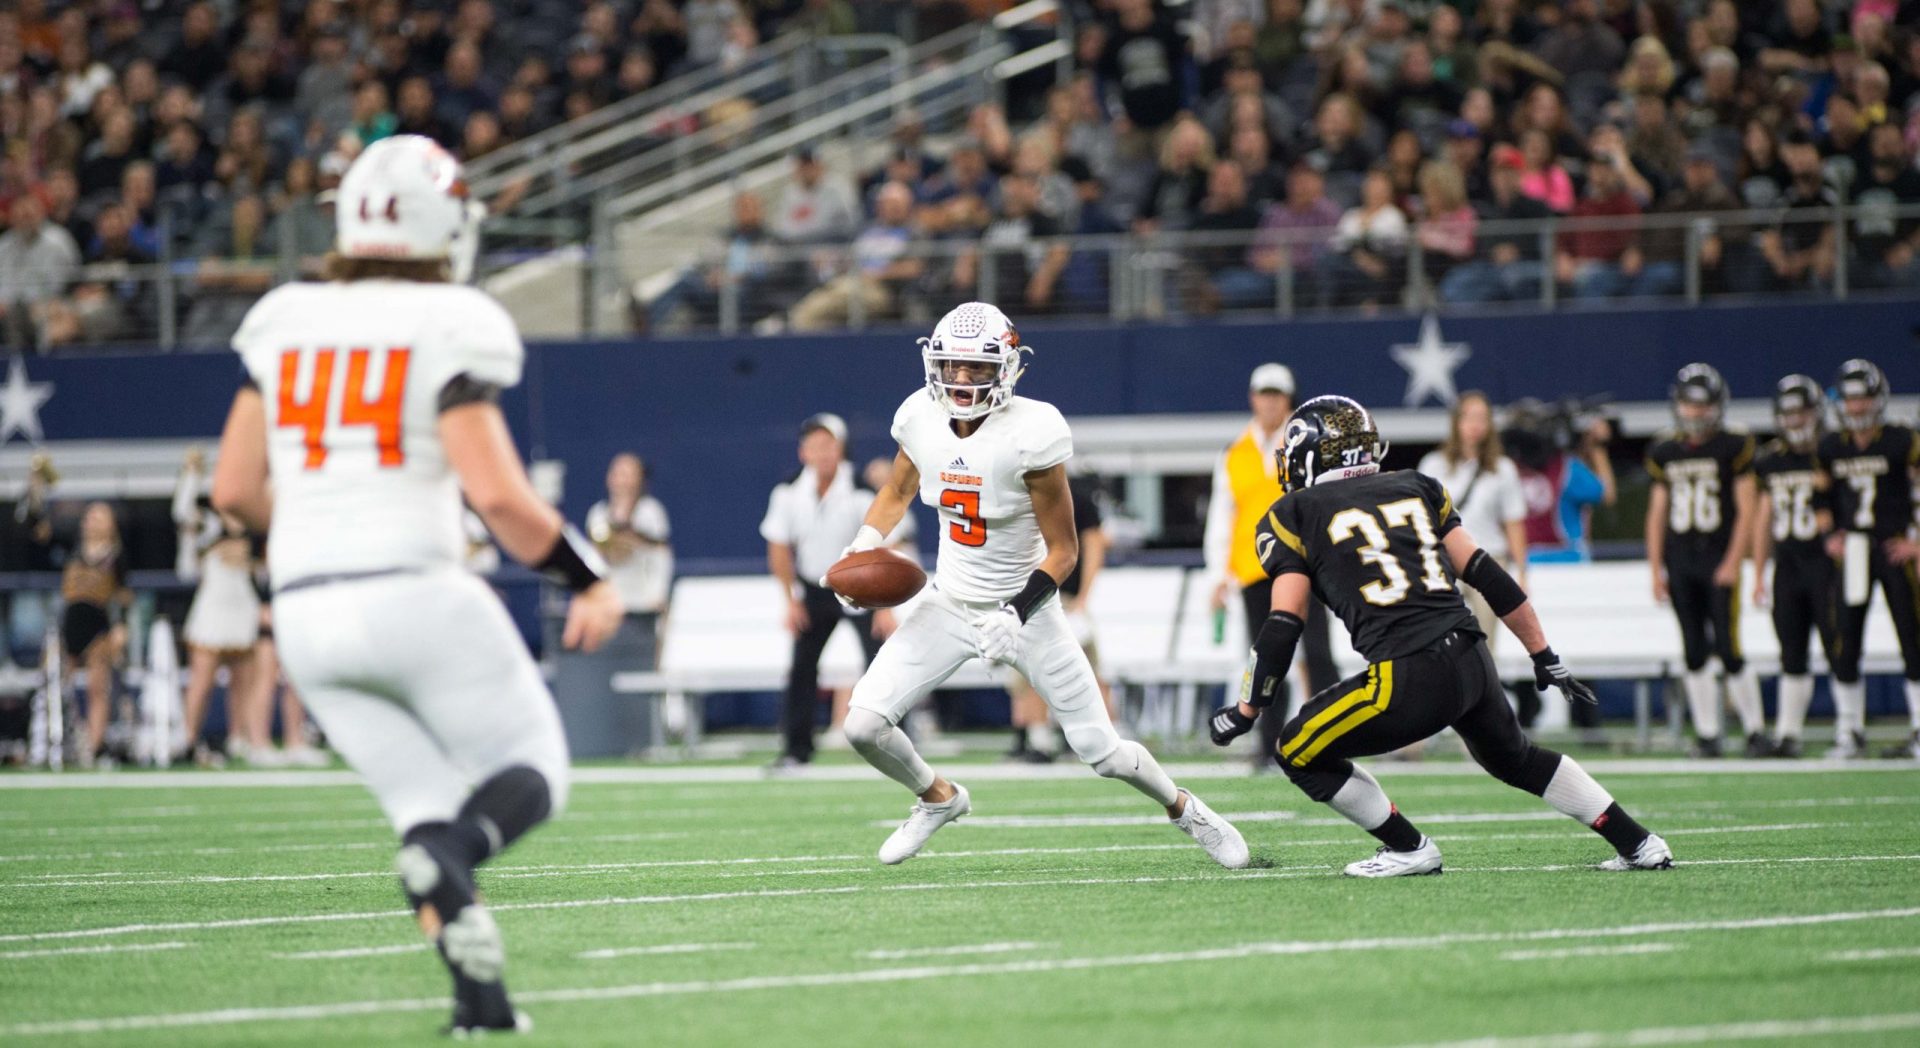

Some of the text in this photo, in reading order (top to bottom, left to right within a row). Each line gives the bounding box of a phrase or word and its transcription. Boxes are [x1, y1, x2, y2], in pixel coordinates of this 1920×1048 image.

[277, 348, 410, 470] 44
[1341, 449, 1360, 467] 37
[939, 488, 987, 548] 3
[1327, 497, 1453, 608] 37
